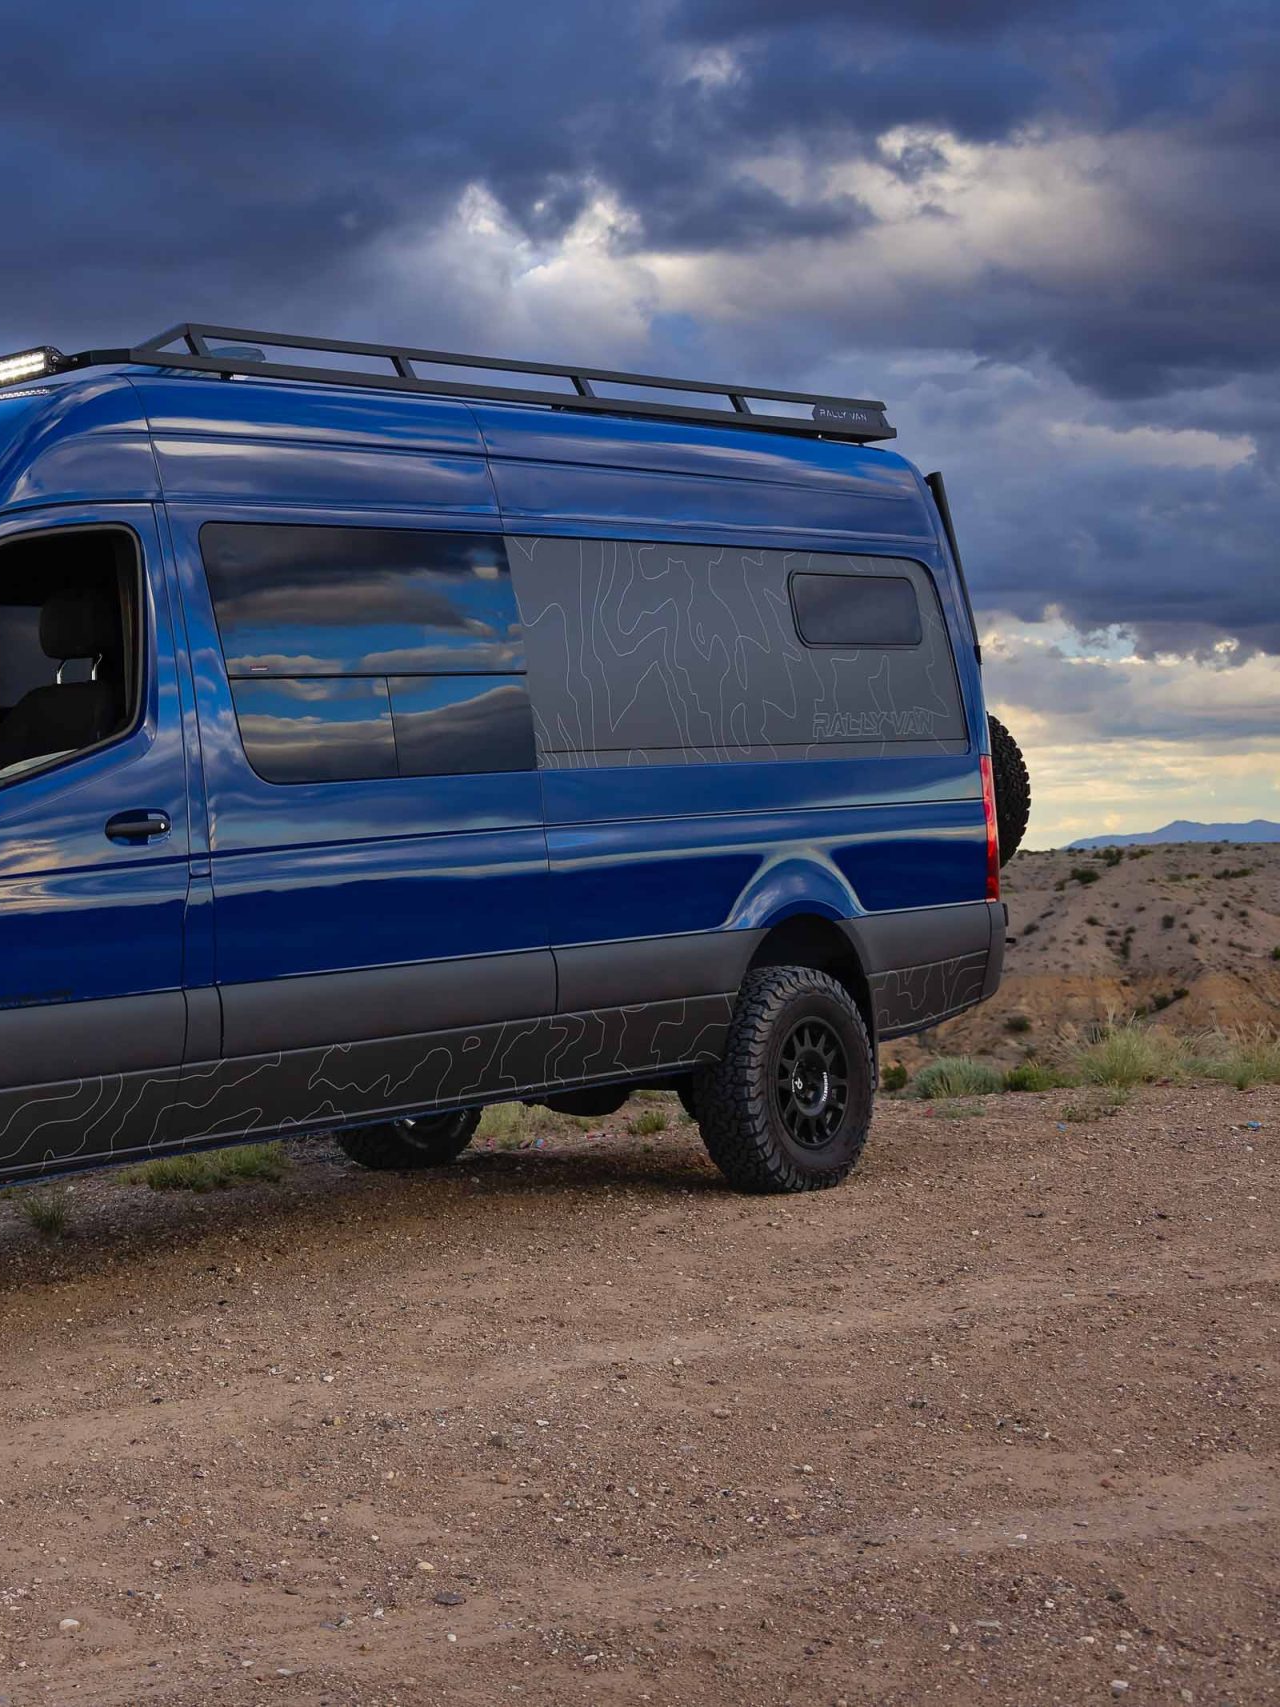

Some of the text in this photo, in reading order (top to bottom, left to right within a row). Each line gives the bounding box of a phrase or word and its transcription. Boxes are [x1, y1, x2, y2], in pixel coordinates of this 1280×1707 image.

[819, 408, 867, 422] RALLY VAN
[813, 711, 934, 738] RALLY VAN
